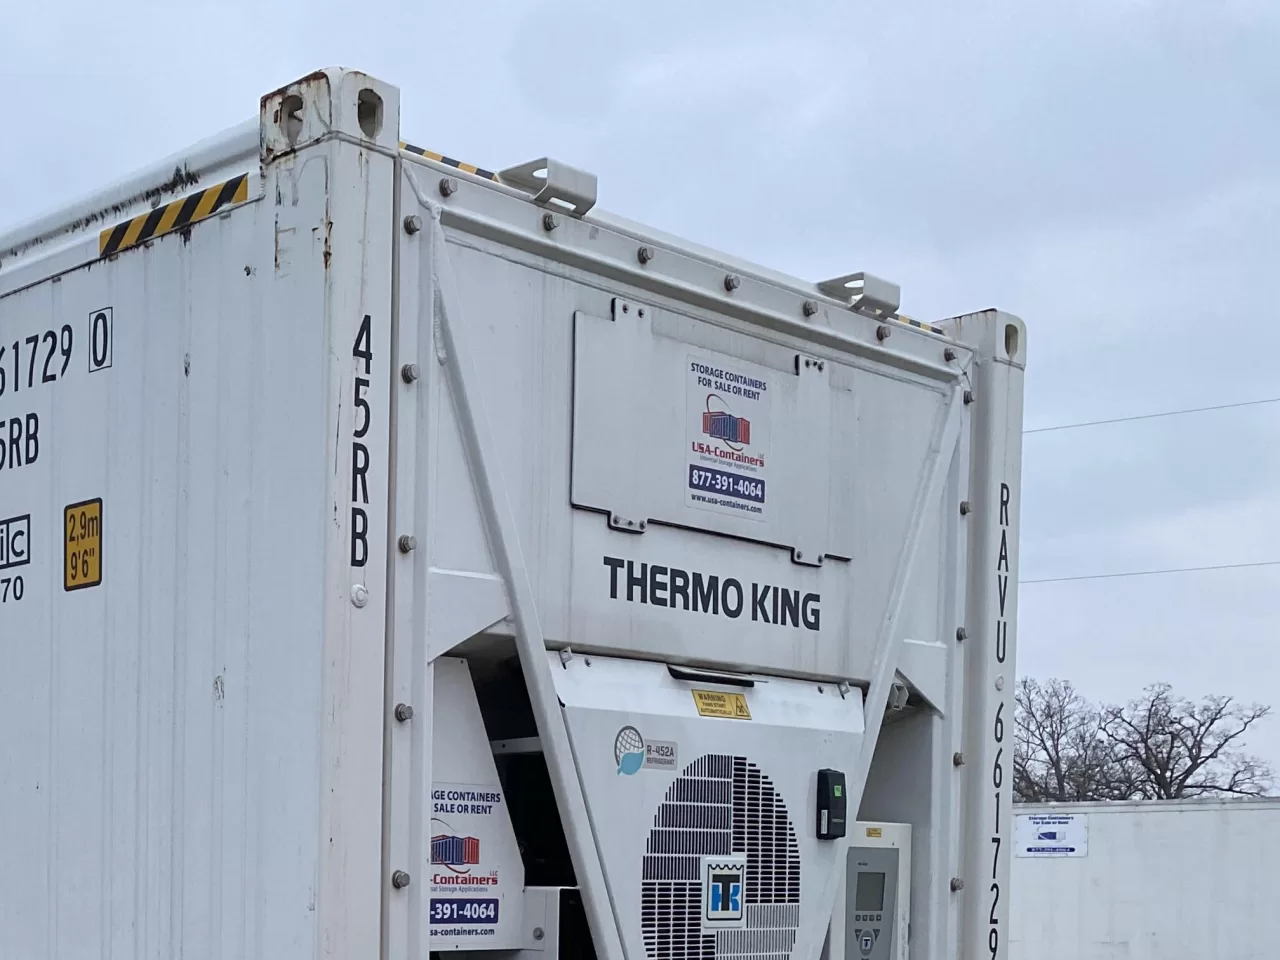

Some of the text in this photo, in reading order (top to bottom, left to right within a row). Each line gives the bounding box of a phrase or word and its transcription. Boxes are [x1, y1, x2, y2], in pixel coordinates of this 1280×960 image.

[91, 311, 109, 368] 0
[690, 362, 767, 391] STORAGE CONTAINERS
[697, 376, 760, 401] FOR SALE OR RENT
[350, 314, 373, 567] 45RB
[692, 441, 765, 467] USA-Containers
[692, 469, 762, 498] 877-391-4064
[691, 494, 762, 514] www.usa-containers.com
[68, 511, 99, 546] 2,9m
[70, 547, 95, 580] 9'6"
[996, 482, 1010, 663] RAVU
[0, 575, 24, 603] 70
[603, 556, 820, 631] THERMO KING
[698, 693, 726, 703] WARNING
[646, 744, 675, 758] R-452A
[433, 803, 493, 815] SALE OR RENT
[447, 790, 501, 803] CONTAINERS
